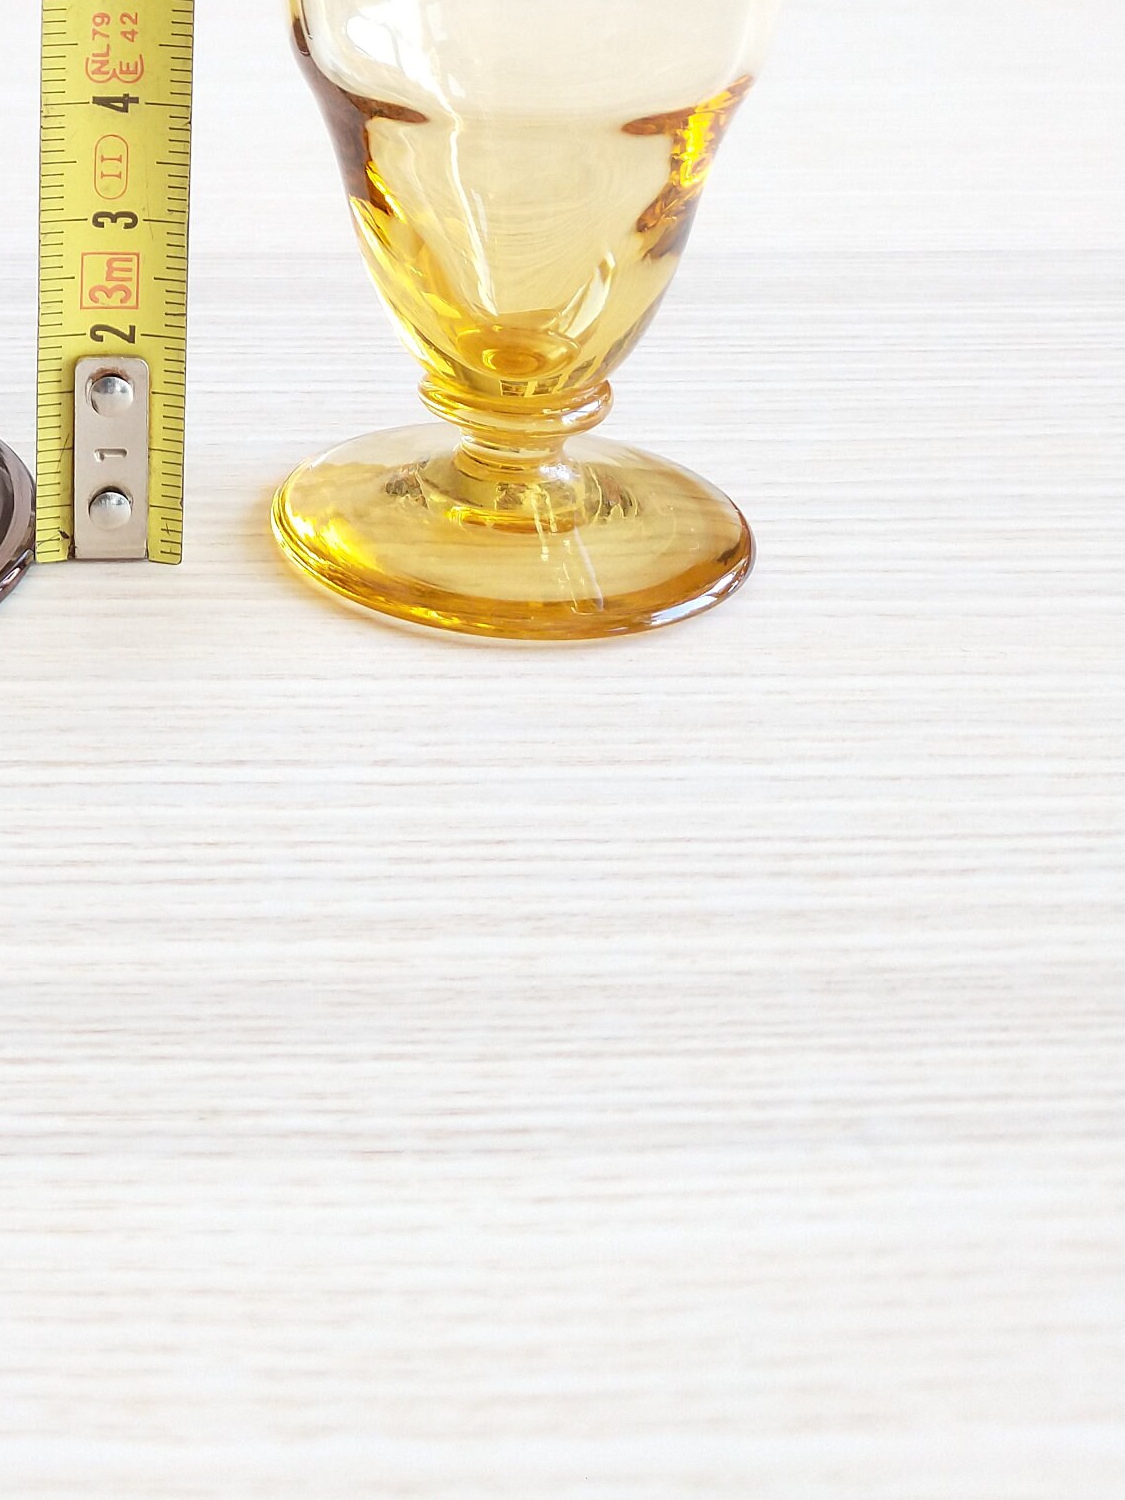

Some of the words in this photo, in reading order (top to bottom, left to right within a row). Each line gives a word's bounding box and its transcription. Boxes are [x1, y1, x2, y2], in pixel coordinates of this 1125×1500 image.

[119, 11, 139, 42] 42
[119, 60, 138, 74] E
[92, 93, 140, 113] 4
[92, 211, 138, 229] 3
[88, 257, 133, 304] 3m
[89, 324, 136, 344] 2
[93, 448, 127, 462] 1
